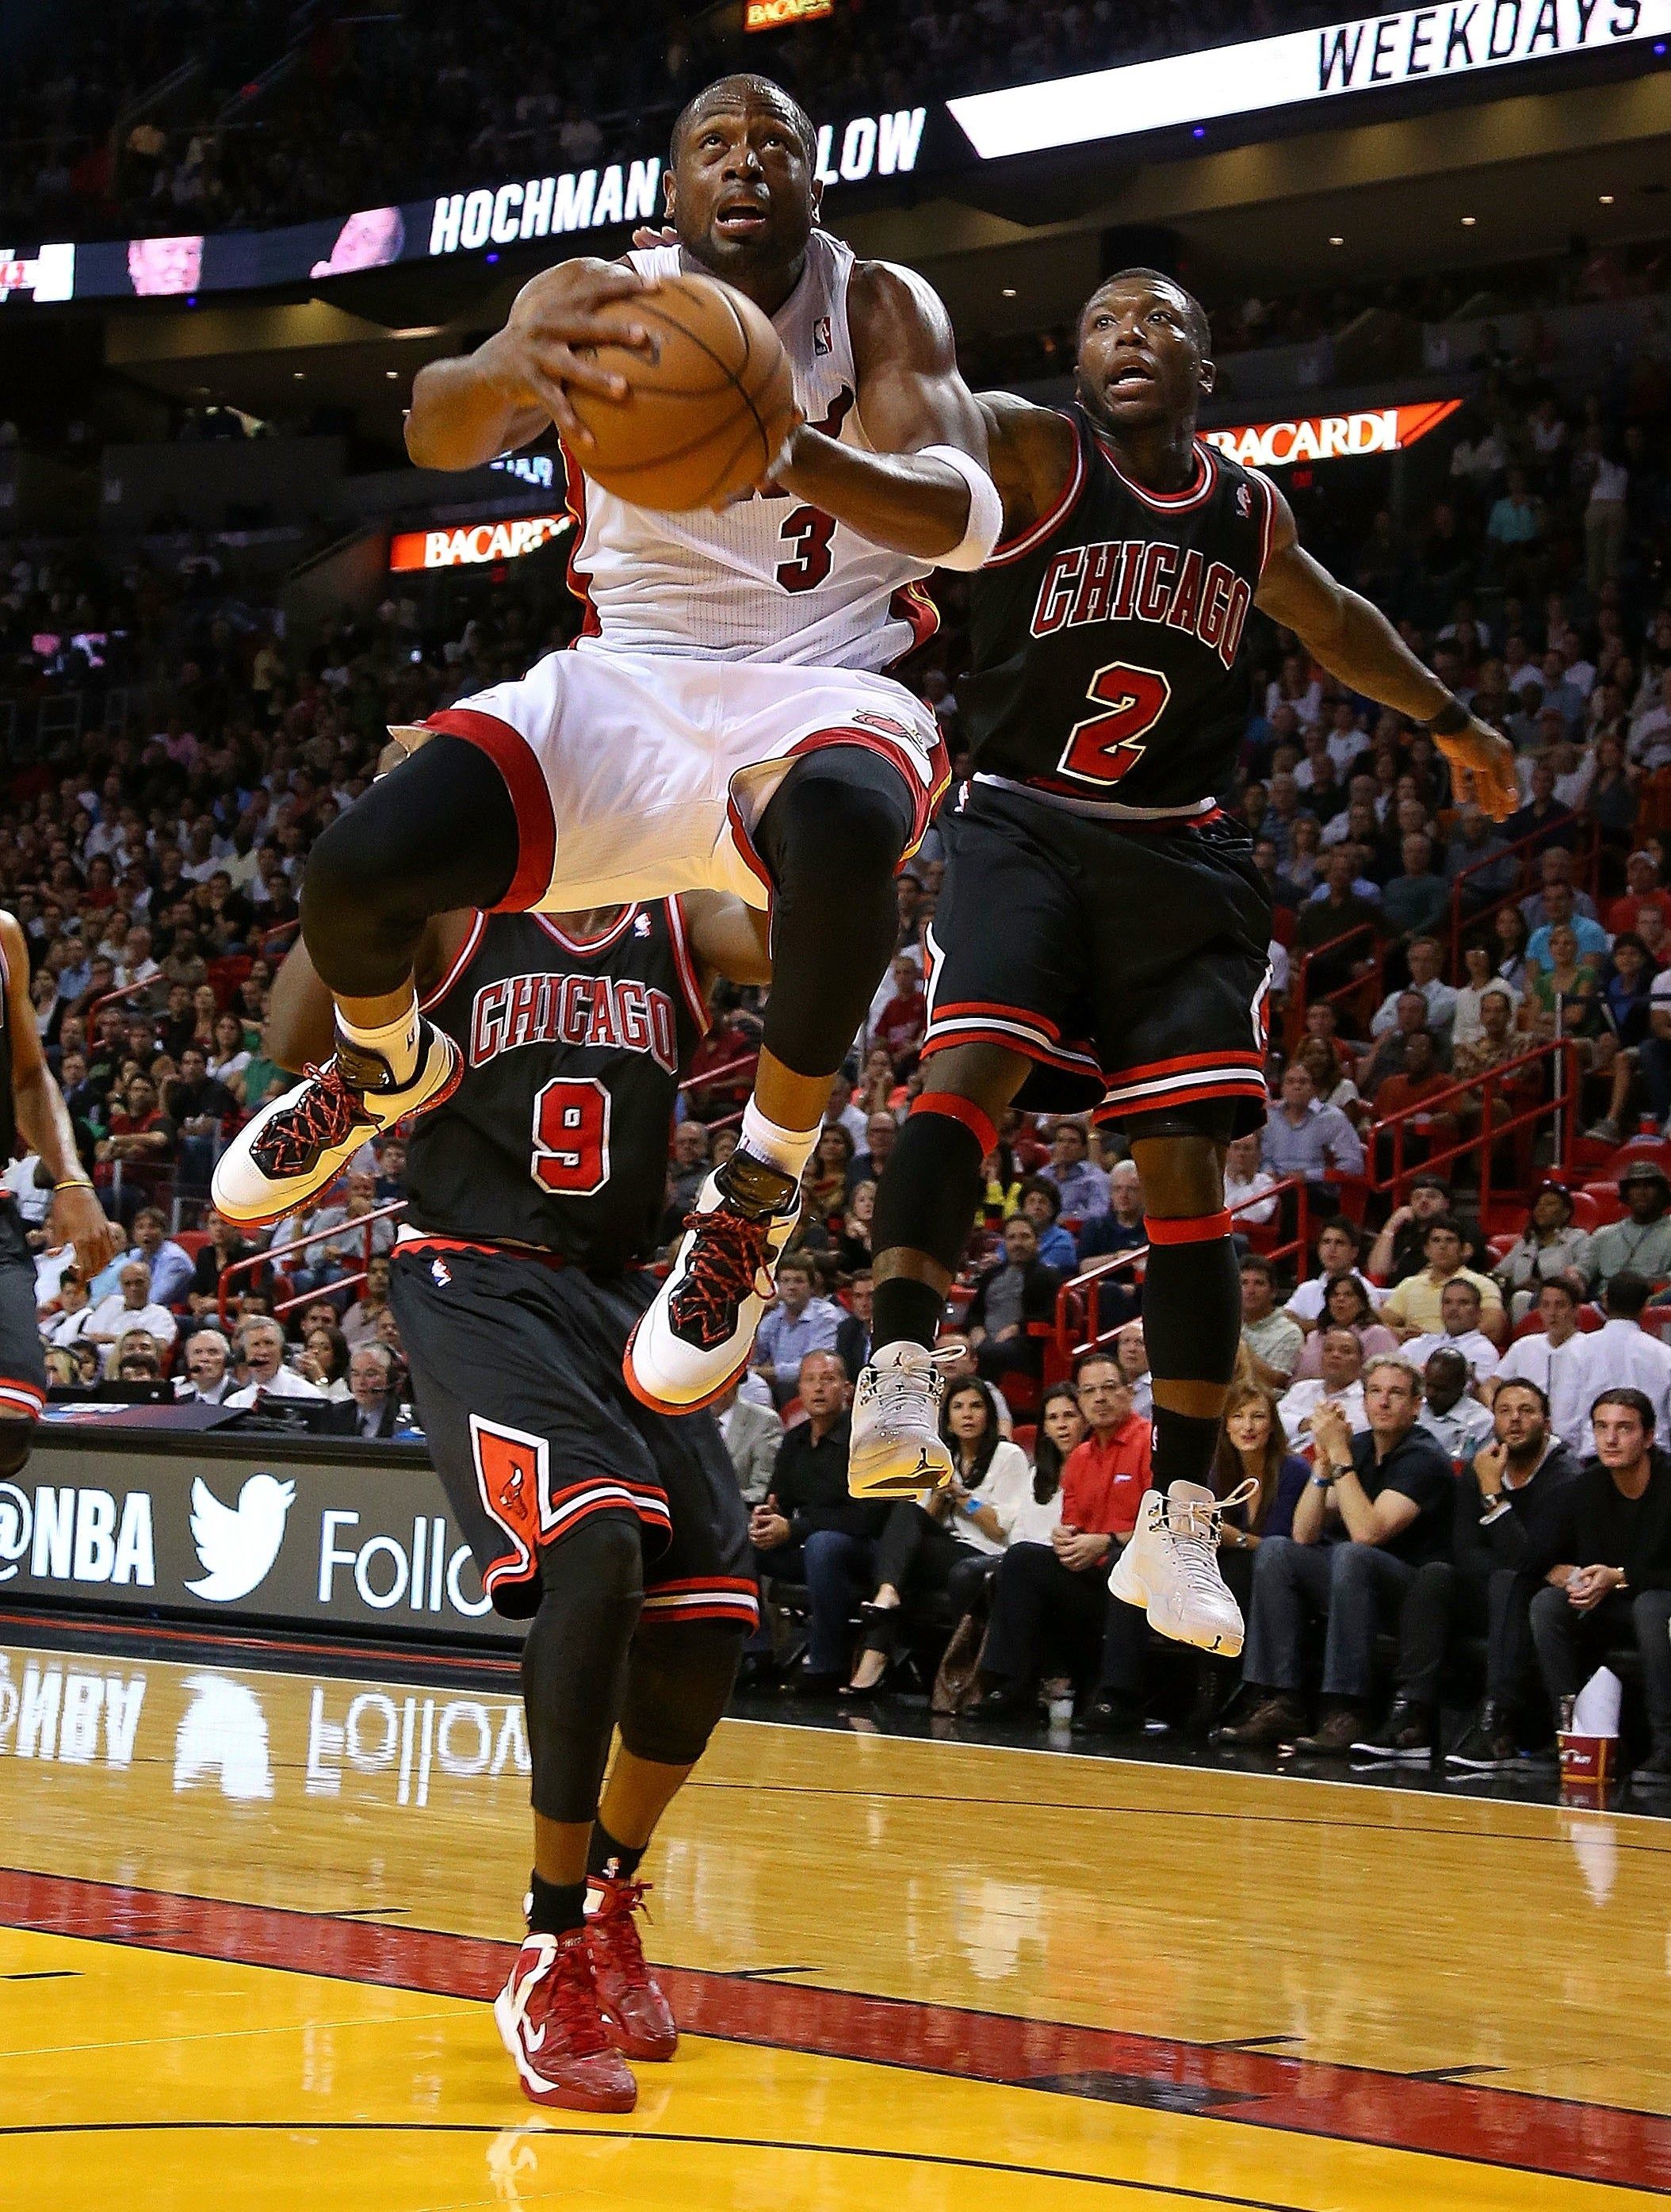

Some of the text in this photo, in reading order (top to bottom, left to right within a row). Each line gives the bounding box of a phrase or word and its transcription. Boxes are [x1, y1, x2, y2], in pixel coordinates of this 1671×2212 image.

[1318, 0, 1641, 91] WEEKDAYS
[429, 107, 927, 255] HOCHMAN LOW
[1206, 409, 1398, 466] BACARDI
[774, 503, 839, 595] 3
[1030, 540, 1251, 670] CHICAGO
[1056, 660, 1172, 786] 2
[469, 972, 679, 1076] CHICAGO
[530, 1077, 611, 1196] 9
[318, 1509, 493, 1617] Follo
